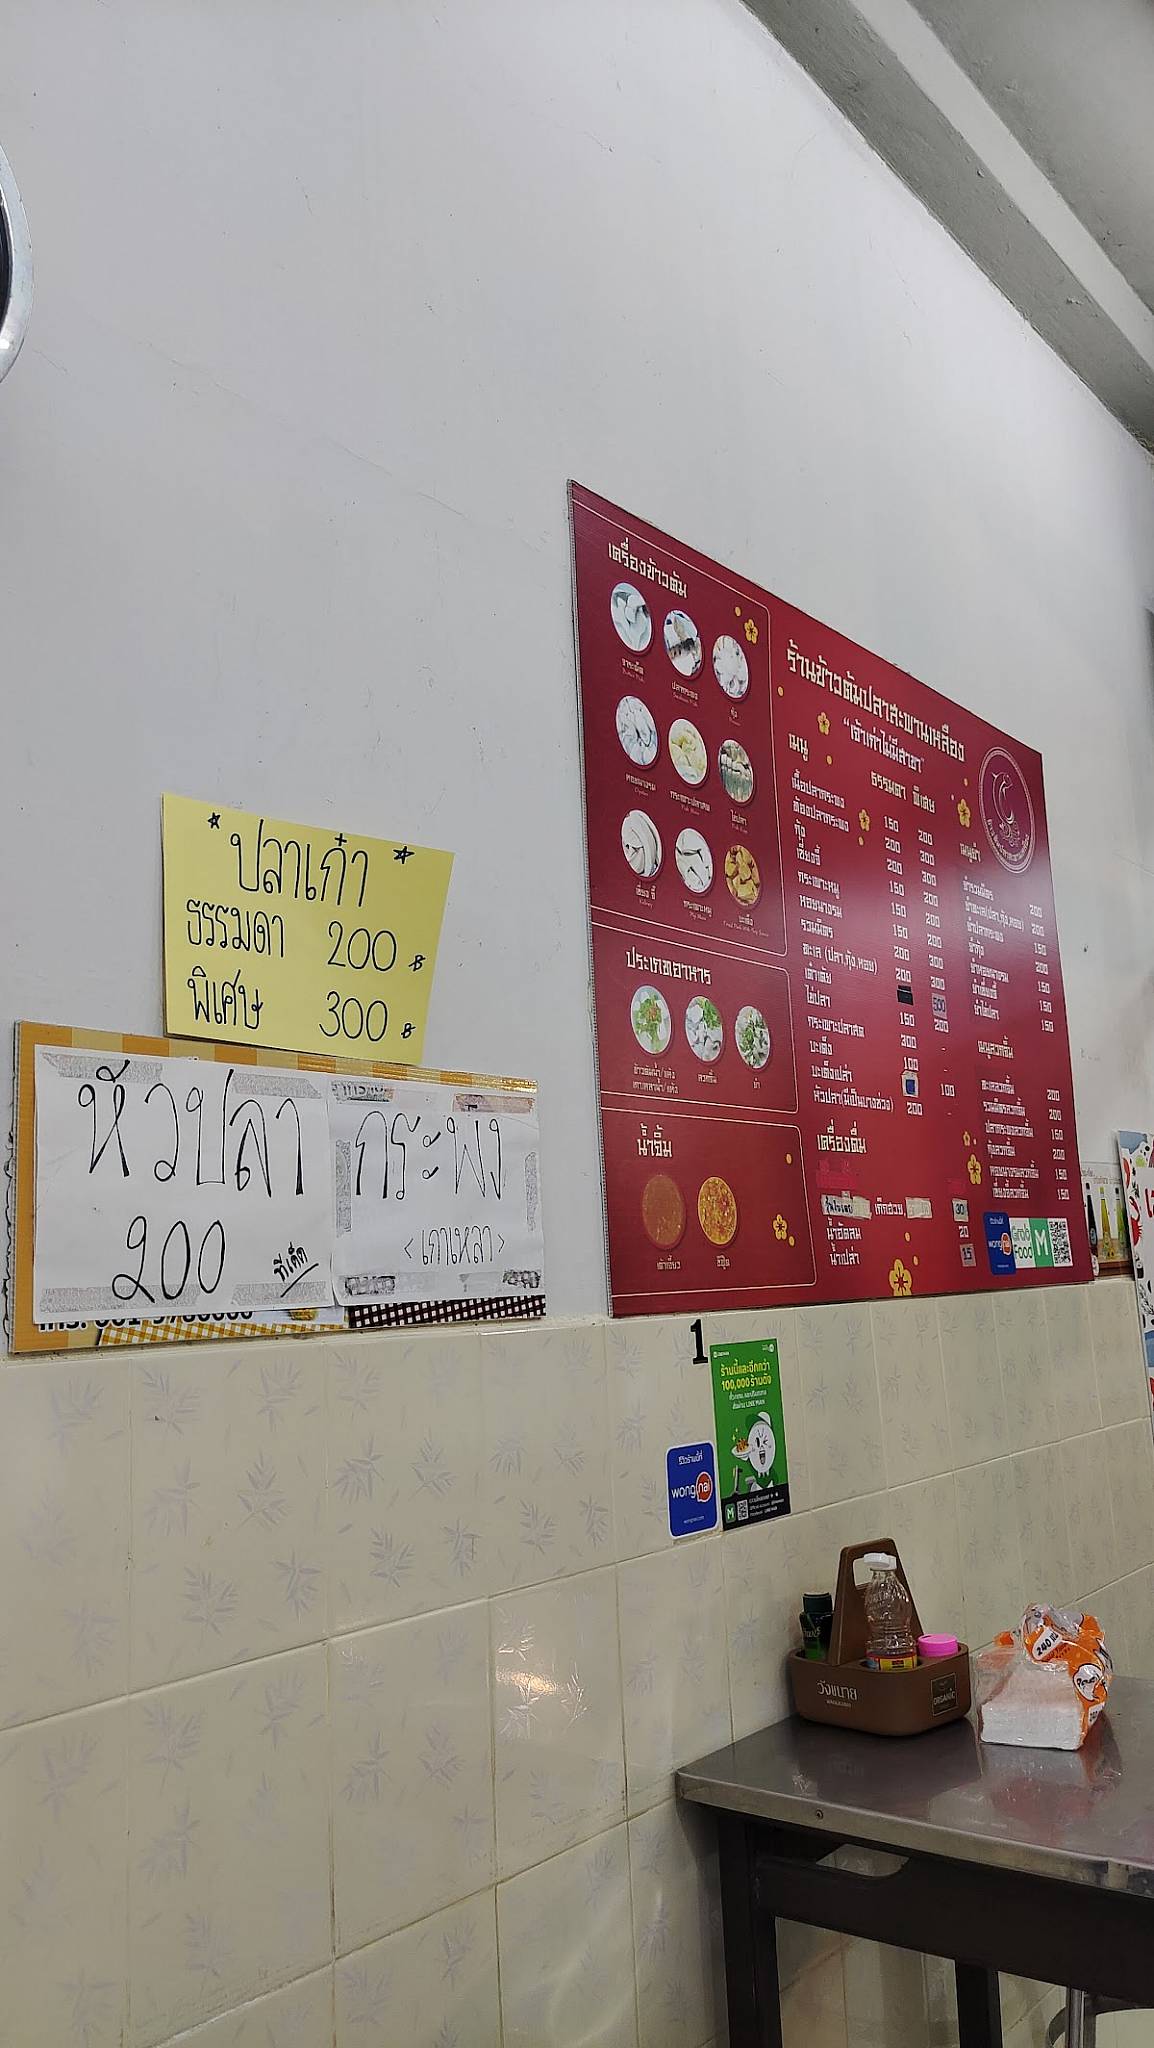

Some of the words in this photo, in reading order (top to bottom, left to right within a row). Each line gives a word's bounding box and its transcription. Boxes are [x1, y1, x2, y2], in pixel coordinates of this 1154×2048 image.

[609, 538, 686, 597] เครื่องข้าวต้ม
[788, 642, 964, 760] ร้านข้าวต้มปลาสะพานเหลือง
[789, 734, 808, 761] เมนู
[871, 772, 906, 799] ธรรมดา
[913, 786, 935, 813] พิเศษ
[885, 816, 898, 832] 150
[918, 830, 932, 845] 200
[230, 819, 369, 908] ปลาเก๋า
[795, 819, 805, 841] กุ้ง
[887, 859, 902, 875] 200
[922, 871, 936, 886] 300
[885, 837, 900, 853] 200
[920, 850, 934, 865] 300
[798, 872, 839, 899] กระเพาะหมู
[892, 903, 906, 918] 150
[926, 913, 940, 927] 200
[890, 881, 904, 896] 150
[924, 892, 938, 907] 200
[187, 899, 285, 957] ธรรมดา
[327, 920, 397, 972] 200
[800, 896, 842, 918] หอยนางรม
[893, 924, 908, 939] 150
[927, 933, 942, 948] 200
[801, 919, 833, 938] รวมมิตร
[894, 946, 909, 961] 200
[929, 955, 943, 969] 300
[627, 948, 710, 984] ประเภทอาหาร
[896, 968, 911, 982] 200
[931, 976, 945, 990] 300
[187, 966, 263, 1029] พิเศษ
[319, 991, 389, 1041] 300
[805, 985, 830, 1007] ไข่ปลา
[900, 1012, 914, 1026] 150
[934, 1019, 949, 1032] 200
[901, 1034, 916, 1048] 300
[904, 1057, 918, 1071] 100
[941, 1084, 955, 1096] 100
[1047, 1090, 1060, 1101] 200
[907, 1102, 922, 1115] 200
[1049, 1109, 1061, 1120] 200
[77, 1060, 304, 1197] หัวปลา
[354, 1110, 504, 1201] กระพง
[638, 1124, 671, 1157] น้ำจิ้ม
[818, 1120, 866, 1152] เครื่องดื่ม
[1051, 1129, 1063, 1140] 150
[1053, 1149, 1065, 1160] 200
[1055, 1169, 1067, 1180] 150
[1058, 1189, 1069, 1200] 150
[827, 1216, 861, 1240] น้ำอัดลม
[959, 1226, 969, 1238] 20
[111, 1216, 226, 1304] 200
[830, 1243, 859, 1265] น้ำเปล่า
[690, 1319, 708, 1364] 1
[721, 1378, 750, 1391] 100,000
[671, 1479, 711, 1499] wongnai
[1036, 1637, 1053, 1656] 240
[816, 1680, 857, 1700] วังขนาย
